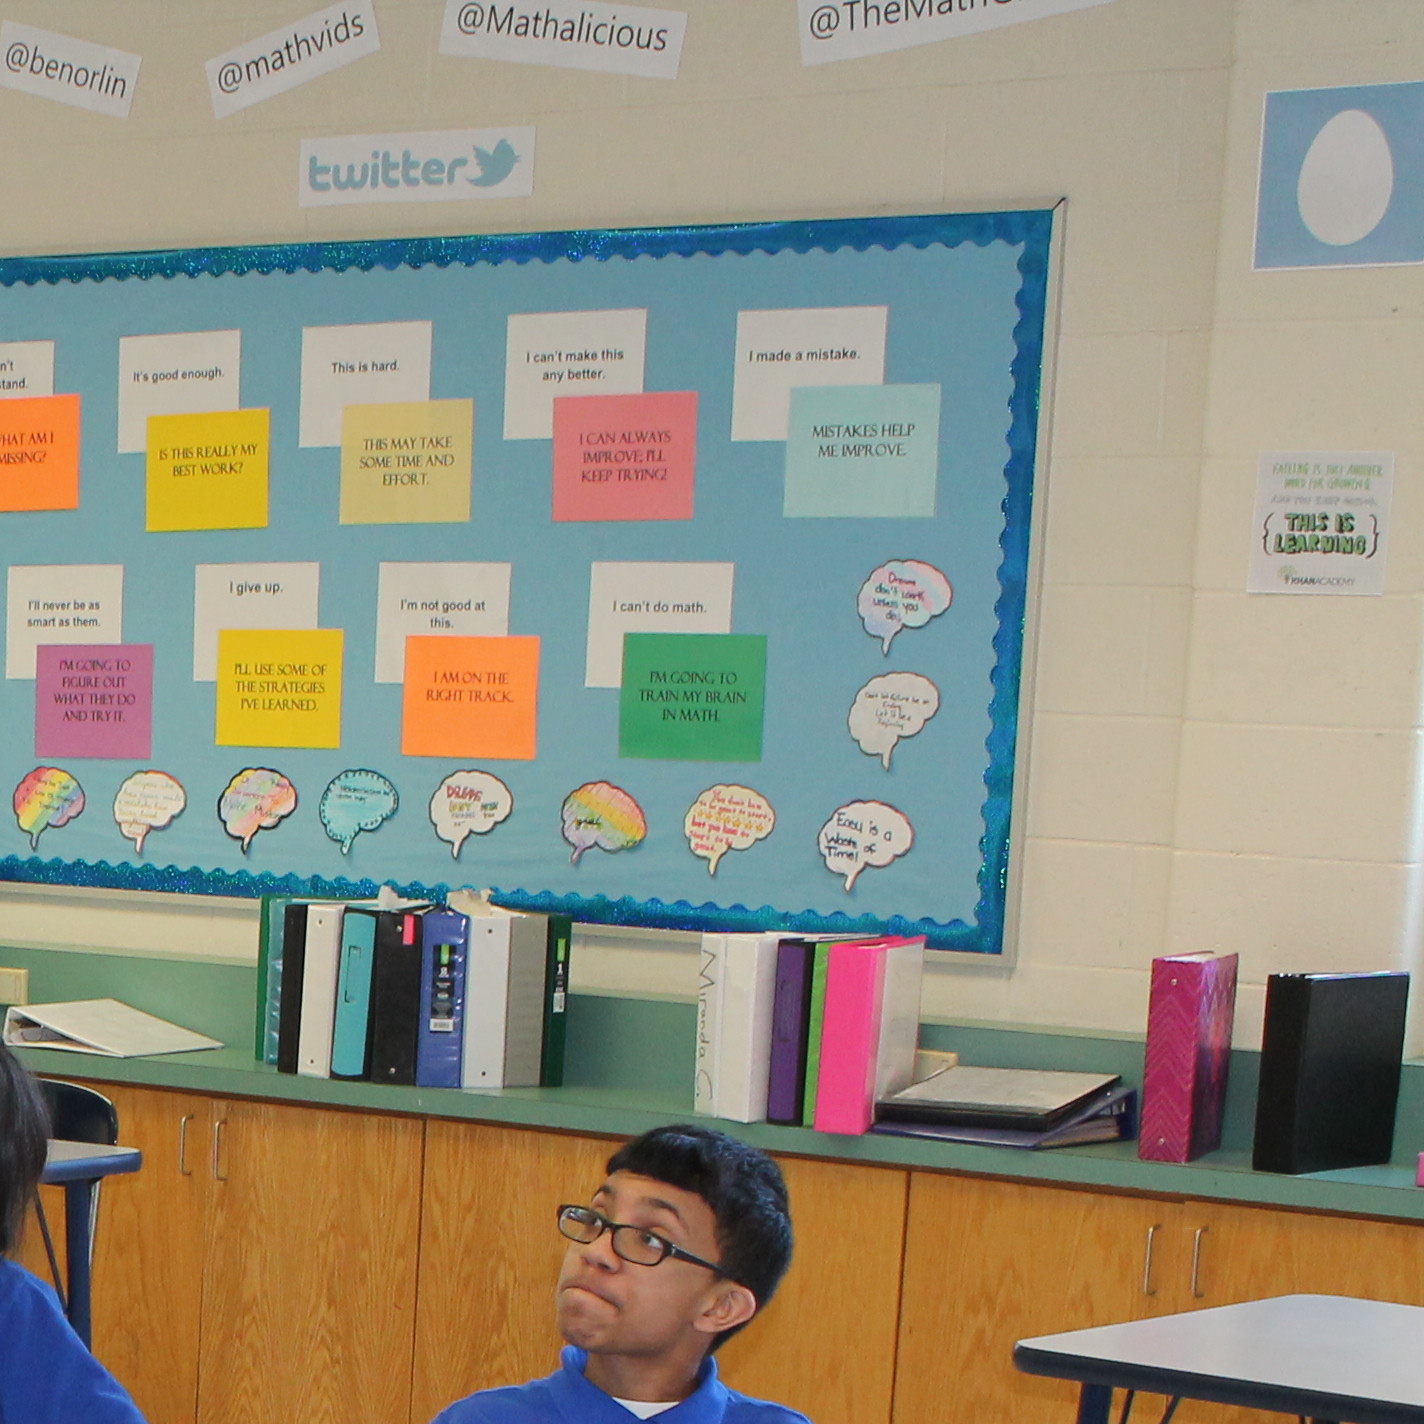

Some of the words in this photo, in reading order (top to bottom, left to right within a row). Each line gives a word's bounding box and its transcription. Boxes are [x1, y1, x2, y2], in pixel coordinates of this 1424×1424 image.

[457, 1, 668, 52] @Mathalicious
[217, 11, 365, 94] @mathvids
[5, 42, 127, 99] @benorlin
[308, 149, 468, 192] twitter
[526, 352, 530, 363] I
[533, 351, 562, 363] can't
[565, 350, 598, 362] make
[601, 349, 624, 362] this
[749, 350, 753, 362] I
[756, 349, 792, 362] made
[795, 352, 802, 361] a
[806, 347, 860, 361] mistake.
[331, 362, 355, 374] This
[358, 361, 368, 373] is
[371, 360, 400, 372] hard.
[133, 371, 149, 383] It's
[152, 369, 177, 383] good
[181, 368, 224, 382] enough.
[542, 370, 564, 383] any
[568, 368, 606, 381] better.
[812, 424, 878, 438] MISTAKES
[881, 423, 916, 437] HELP
[28, 432, 46, 445] AM
[363, 438, 388, 451] THIS
[390, 437, 417, 450] MAY
[419, 436, 453, 449] TAKE
[586, 432, 616, 445] CAN
[619, 431, 671, 445] ALWAYS
[159, 448, 168, 460] IS
[171, 447, 192, 460] THIS
[196, 445, 237, 459] REALLY
[240, 444, 258, 456] MY
[818, 444, 838, 458] ME
[359, 456, 391, 469] SOME
[395, 455, 423, 468] TIME
[425, 454, 455, 467] AND
[172, 464, 197, 477] BEST
[201, 462, 243, 476] WORK?
[581, 468, 613, 482] KEEP
[616, 467, 668, 482] TRYING!
[383, 473, 429, 486] EFFORT.
[1284, 512, 1329, 532] THIS
[1335, 512, 1356, 533] IS
[1273, 533, 1367, 555] LEARNING
[230, 581, 233, 593] I
[236, 581, 261, 596] give
[265, 583, 283, 596] up.
[28, 601, 40, 611] I'll
[43, 602, 70, 611] never
[73, 600, 86, 611] be
[88, 602, 100, 611] as
[400, 599, 418, 611] I'm
[420, 600, 438, 612] not
[441, 599, 470, 614] good
[474, 600, 485, 612] at
[613, 600, 616, 612] I
[619, 600, 650, 612] can't
[653, 601, 669, 613] do
[672, 601, 707, 613] math.
[27, 617, 56, 627] smart
[58, 619, 70, 628] as
[73, 616, 101, 628] them.
[430, 617, 454, 629] this.
[76, 659, 112, 672] GOING
[115, 659, 131, 672] TO
[254, 664, 274, 676] USE
[277, 663, 309, 676] SOME
[312, 664, 328, 677] OF
[61, 676, 100, 689] FIGURE
[103, 676, 126, 689] OUT
[440, 671, 462, 684] AM
[463, 672, 482, 685] ON
[486, 672, 509, 685] THE
[671, 671, 716, 685] GOING
[719, 672, 737, 685] TO
[235, 680, 257, 693] THE
[259, 681, 325, 694] STRATEGIES
[53, 693, 86, 706] WHAT
[89, 693, 115, 706] THEY
[117, 693, 136, 706] DO
[426, 689, 465, 702] RIGHT
[639, 690, 679, 702] TRAIN
[682, 690, 702, 703] MY
[705, 690, 747, 703] BRAIN
[62, 710, 88, 722] AND
[91, 710, 113, 722] TRY
[662, 709, 676, 721] IN
[836, 812, 864, 834] Easy
[869, 819, 879, 837] is
[883, 830, 893, 842] a
[863, 843, 876, 855] of
[698, 949, 717, 1058] Miranda
